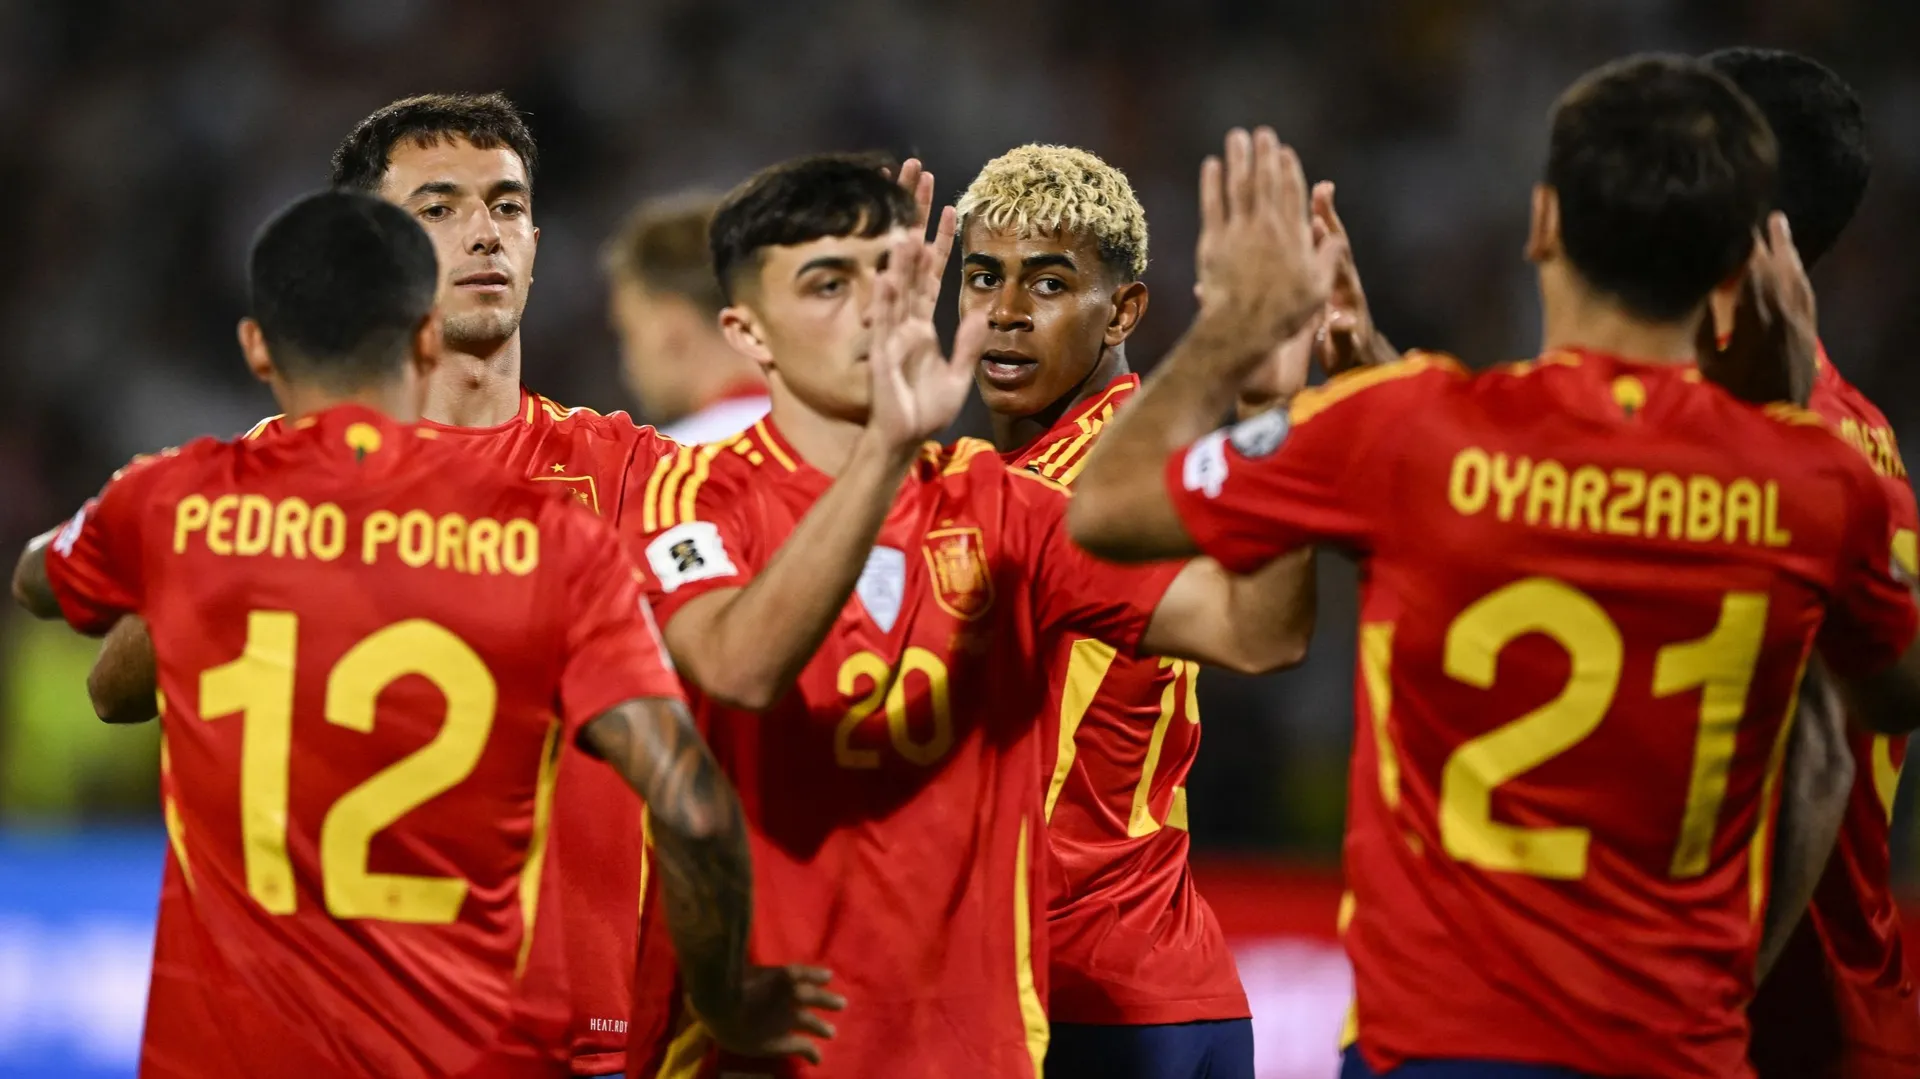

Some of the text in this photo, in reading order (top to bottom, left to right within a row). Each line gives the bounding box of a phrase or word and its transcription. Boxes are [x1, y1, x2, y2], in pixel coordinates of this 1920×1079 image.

[173, 494, 540, 576] PEDRO PORRO
[1449, 448, 1790, 547] OYARZABAL
[199, 610, 498, 924] 12
[834, 646, 952, 768] 20
[1441, 577, 1769, 881] 21
